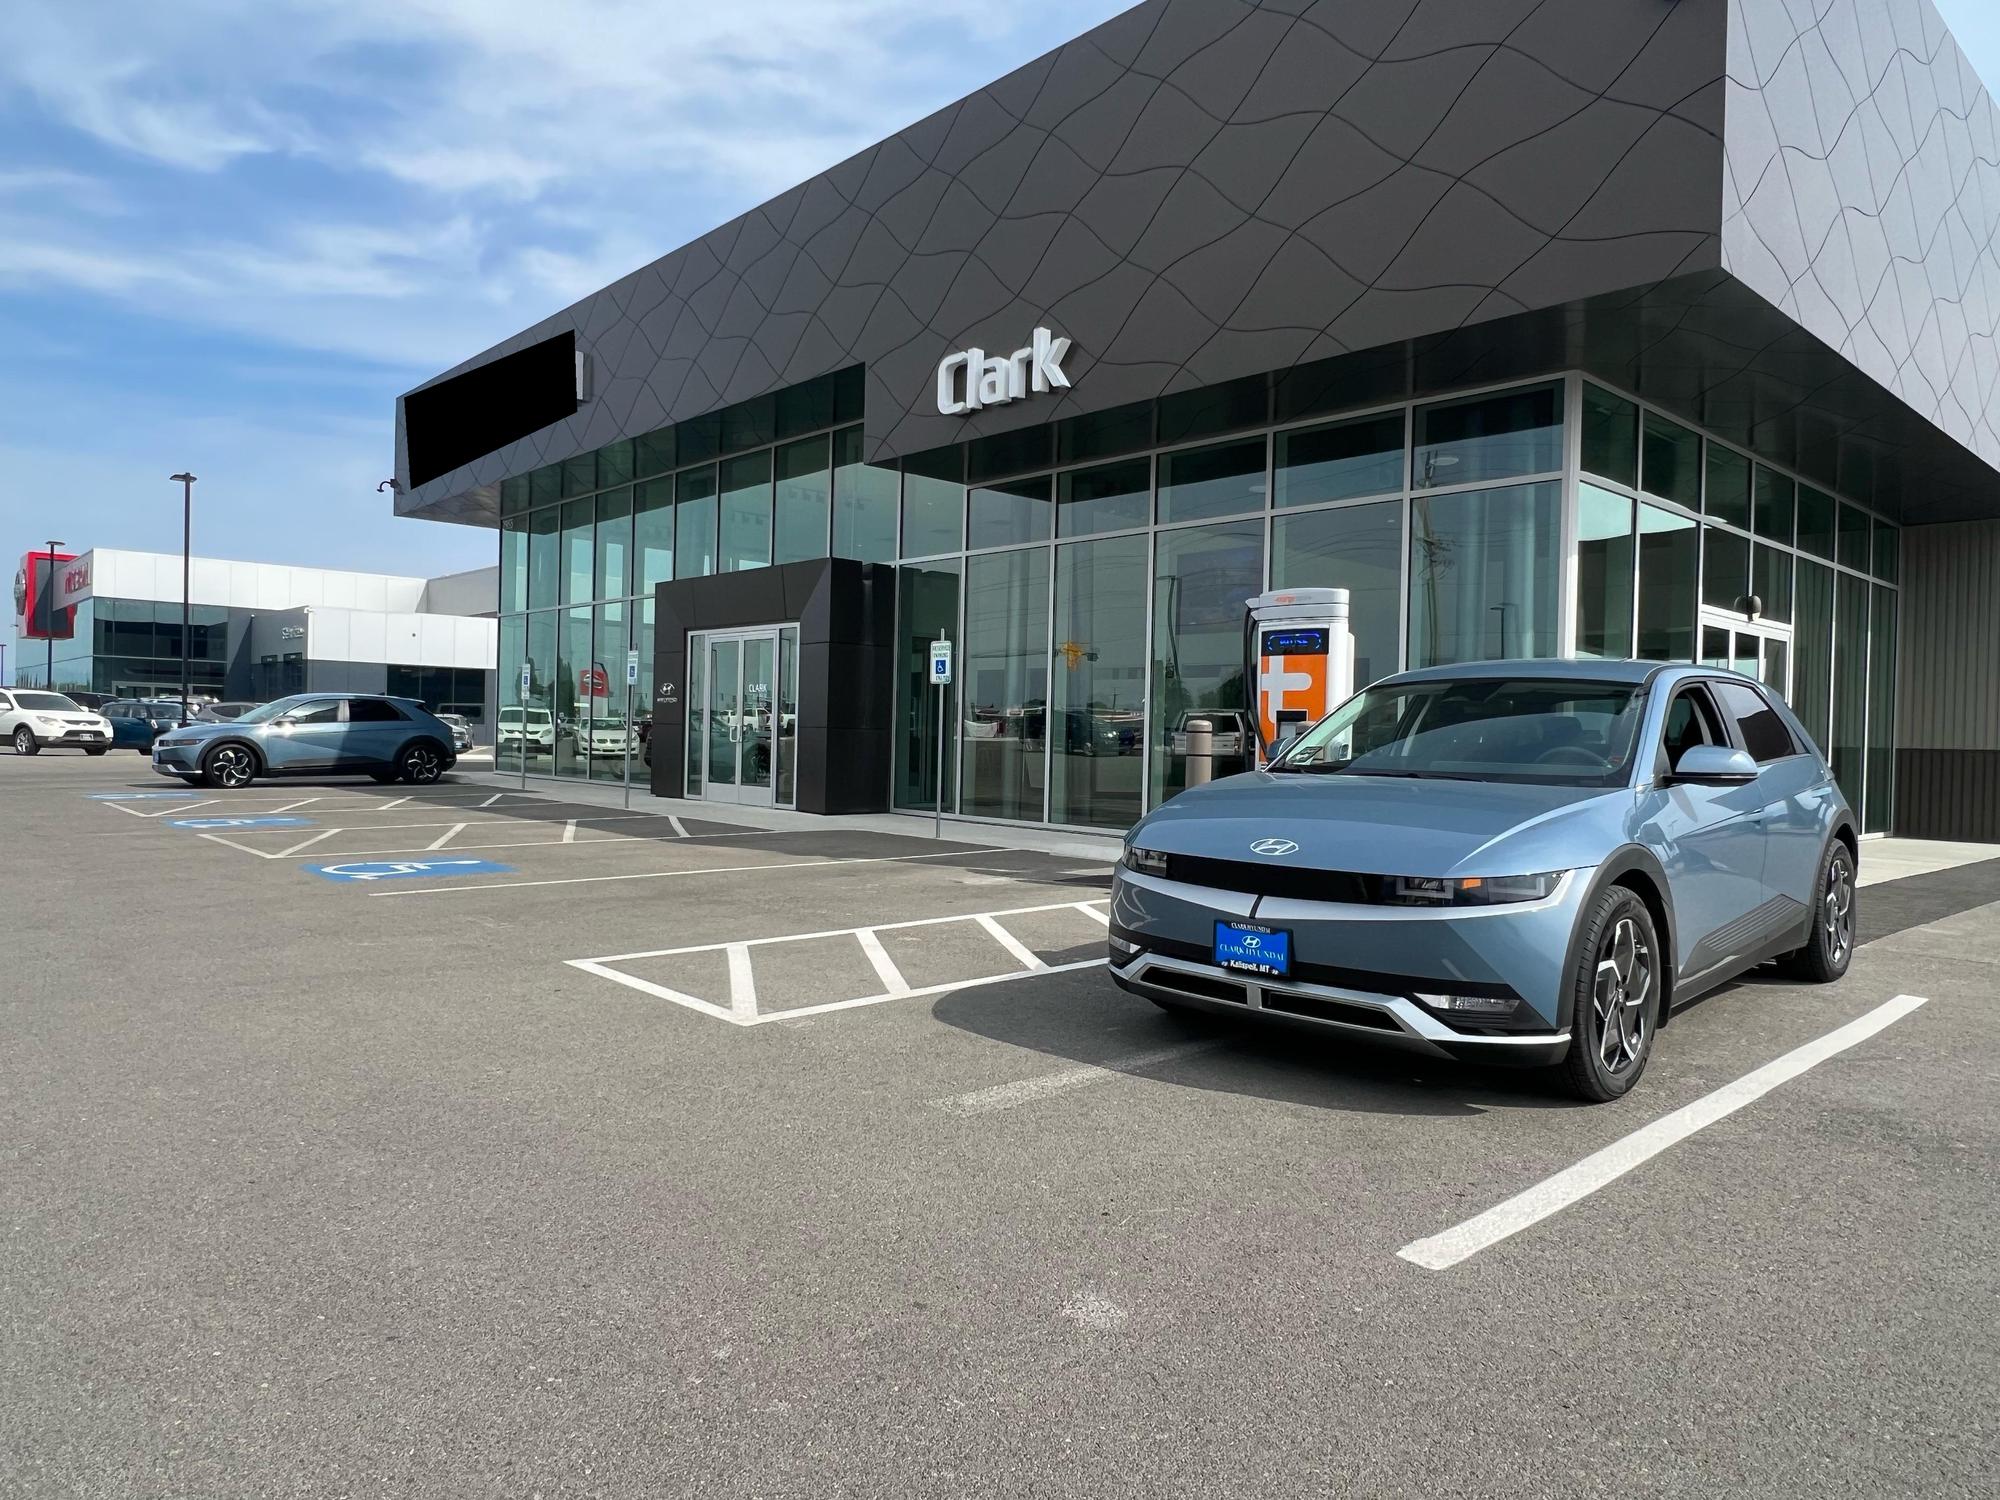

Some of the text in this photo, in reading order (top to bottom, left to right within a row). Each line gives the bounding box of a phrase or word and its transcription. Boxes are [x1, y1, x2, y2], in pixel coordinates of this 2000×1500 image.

[937, 326, 1072, 415] Clark
[748, 683, 768, 693] CLARK
[1219, 943, 1284, 961] CLARK HYUNDAI
[1259, 964, 1270, 974] MT
